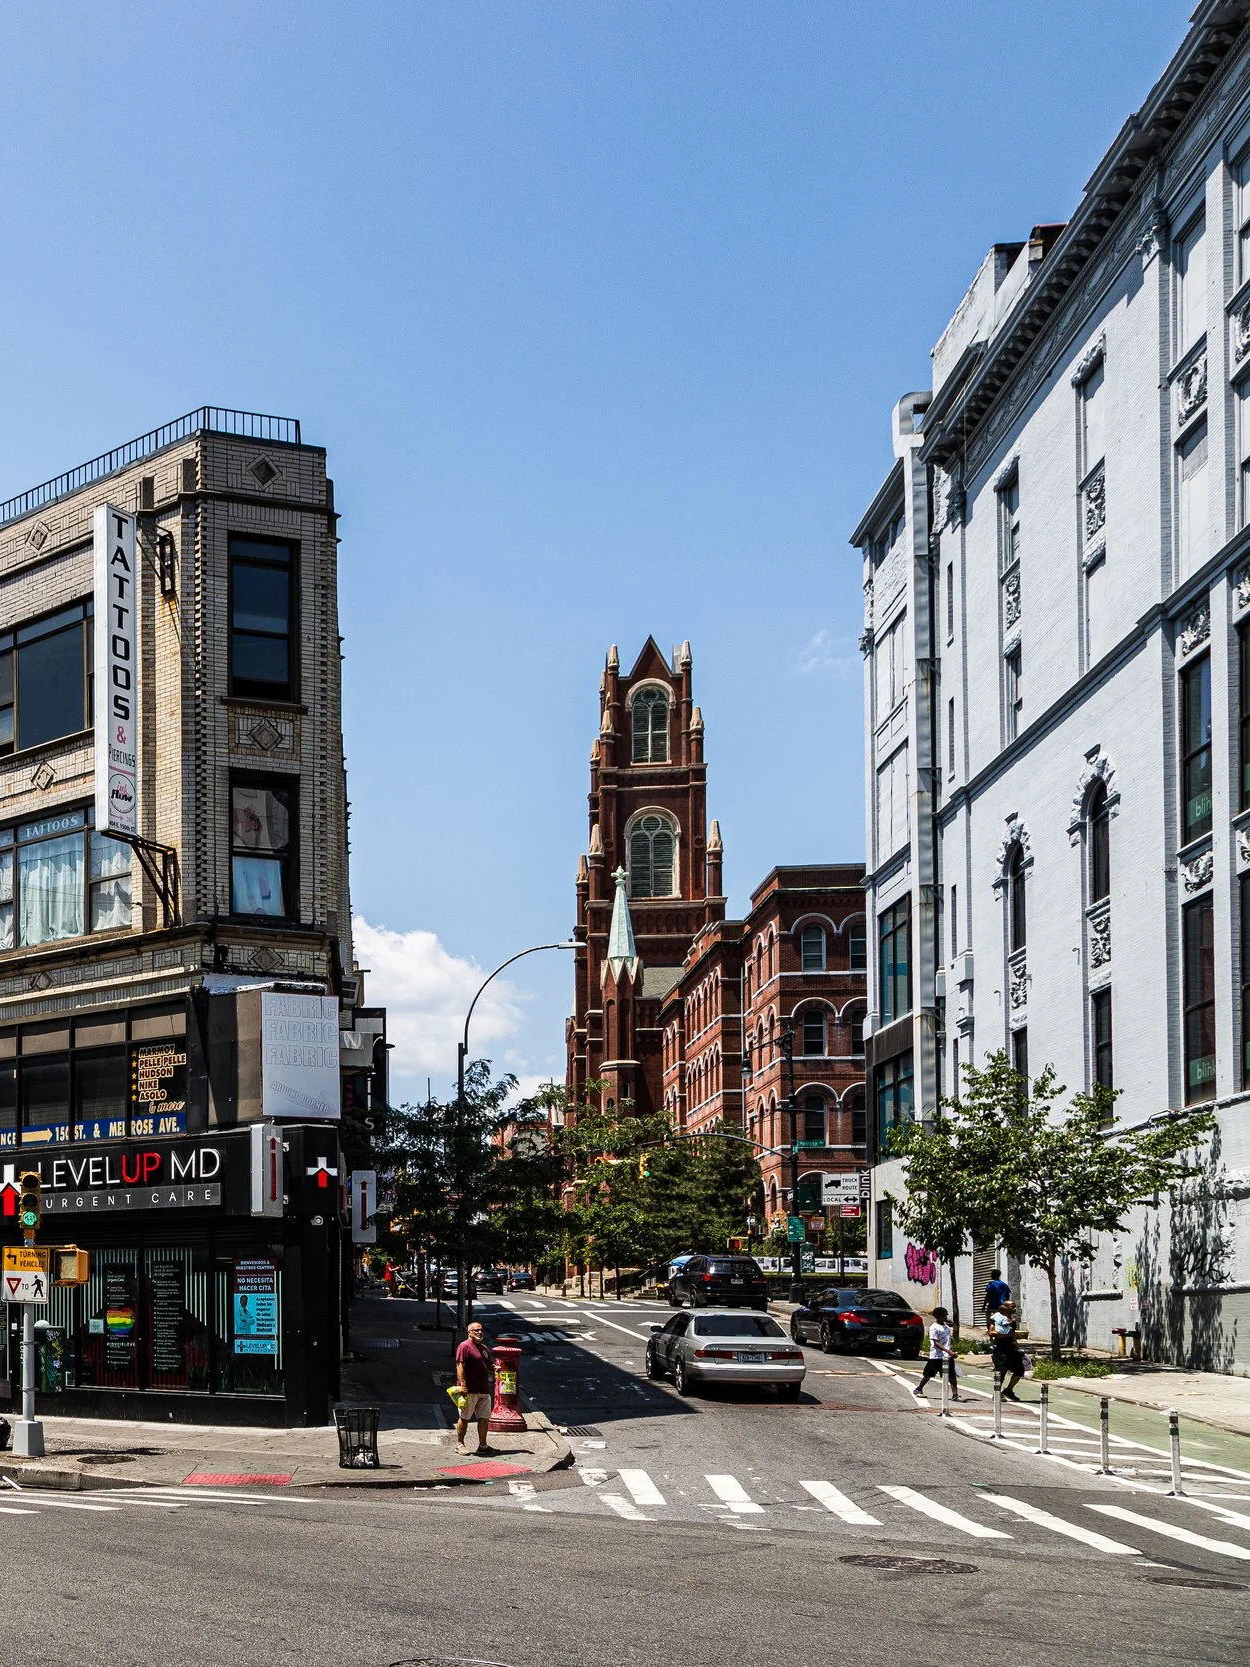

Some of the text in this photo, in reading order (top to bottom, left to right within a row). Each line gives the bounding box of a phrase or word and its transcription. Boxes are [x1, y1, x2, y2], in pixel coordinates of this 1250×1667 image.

[110, 513, 131, 744] TATTOOS &
[108, 744, 135, 767] PIERCINGS
[25, 816, 78, 838] TATTOOS
[265, 996, 336, 1019] FABRIC
[265, 1020, 337, 1043] FABRIC
[138, 1054, 186, 1069] PELLE PELLE
[139, 1045, 175, 1057] MARMOT
[266, 1044, 337, 1068] FABRIC
[138, 1067, 173, 1079] HUDSON
[138, 1079, 158, 1090] NIKE
[139, 1090, 167, 1101] ASOLO
[157, 1102, 185, 1112] more
[270, 1081, 330, 1113] AROUND CORNER
[74, 1125, 86, 1140] ST.
[93, 1124, 100, 1138] &
[158, 1117, 180, 1133] AVE.
[38, 1149, 220, 1188] LEVELUP MD
[860, 1169, 870, 1199] blink
[46, 1189, 212, 1209] URGENT CARE
[19, 1250, 46, 1259] TURNING
[19, 1260, 46, 1268] VEHICLES
